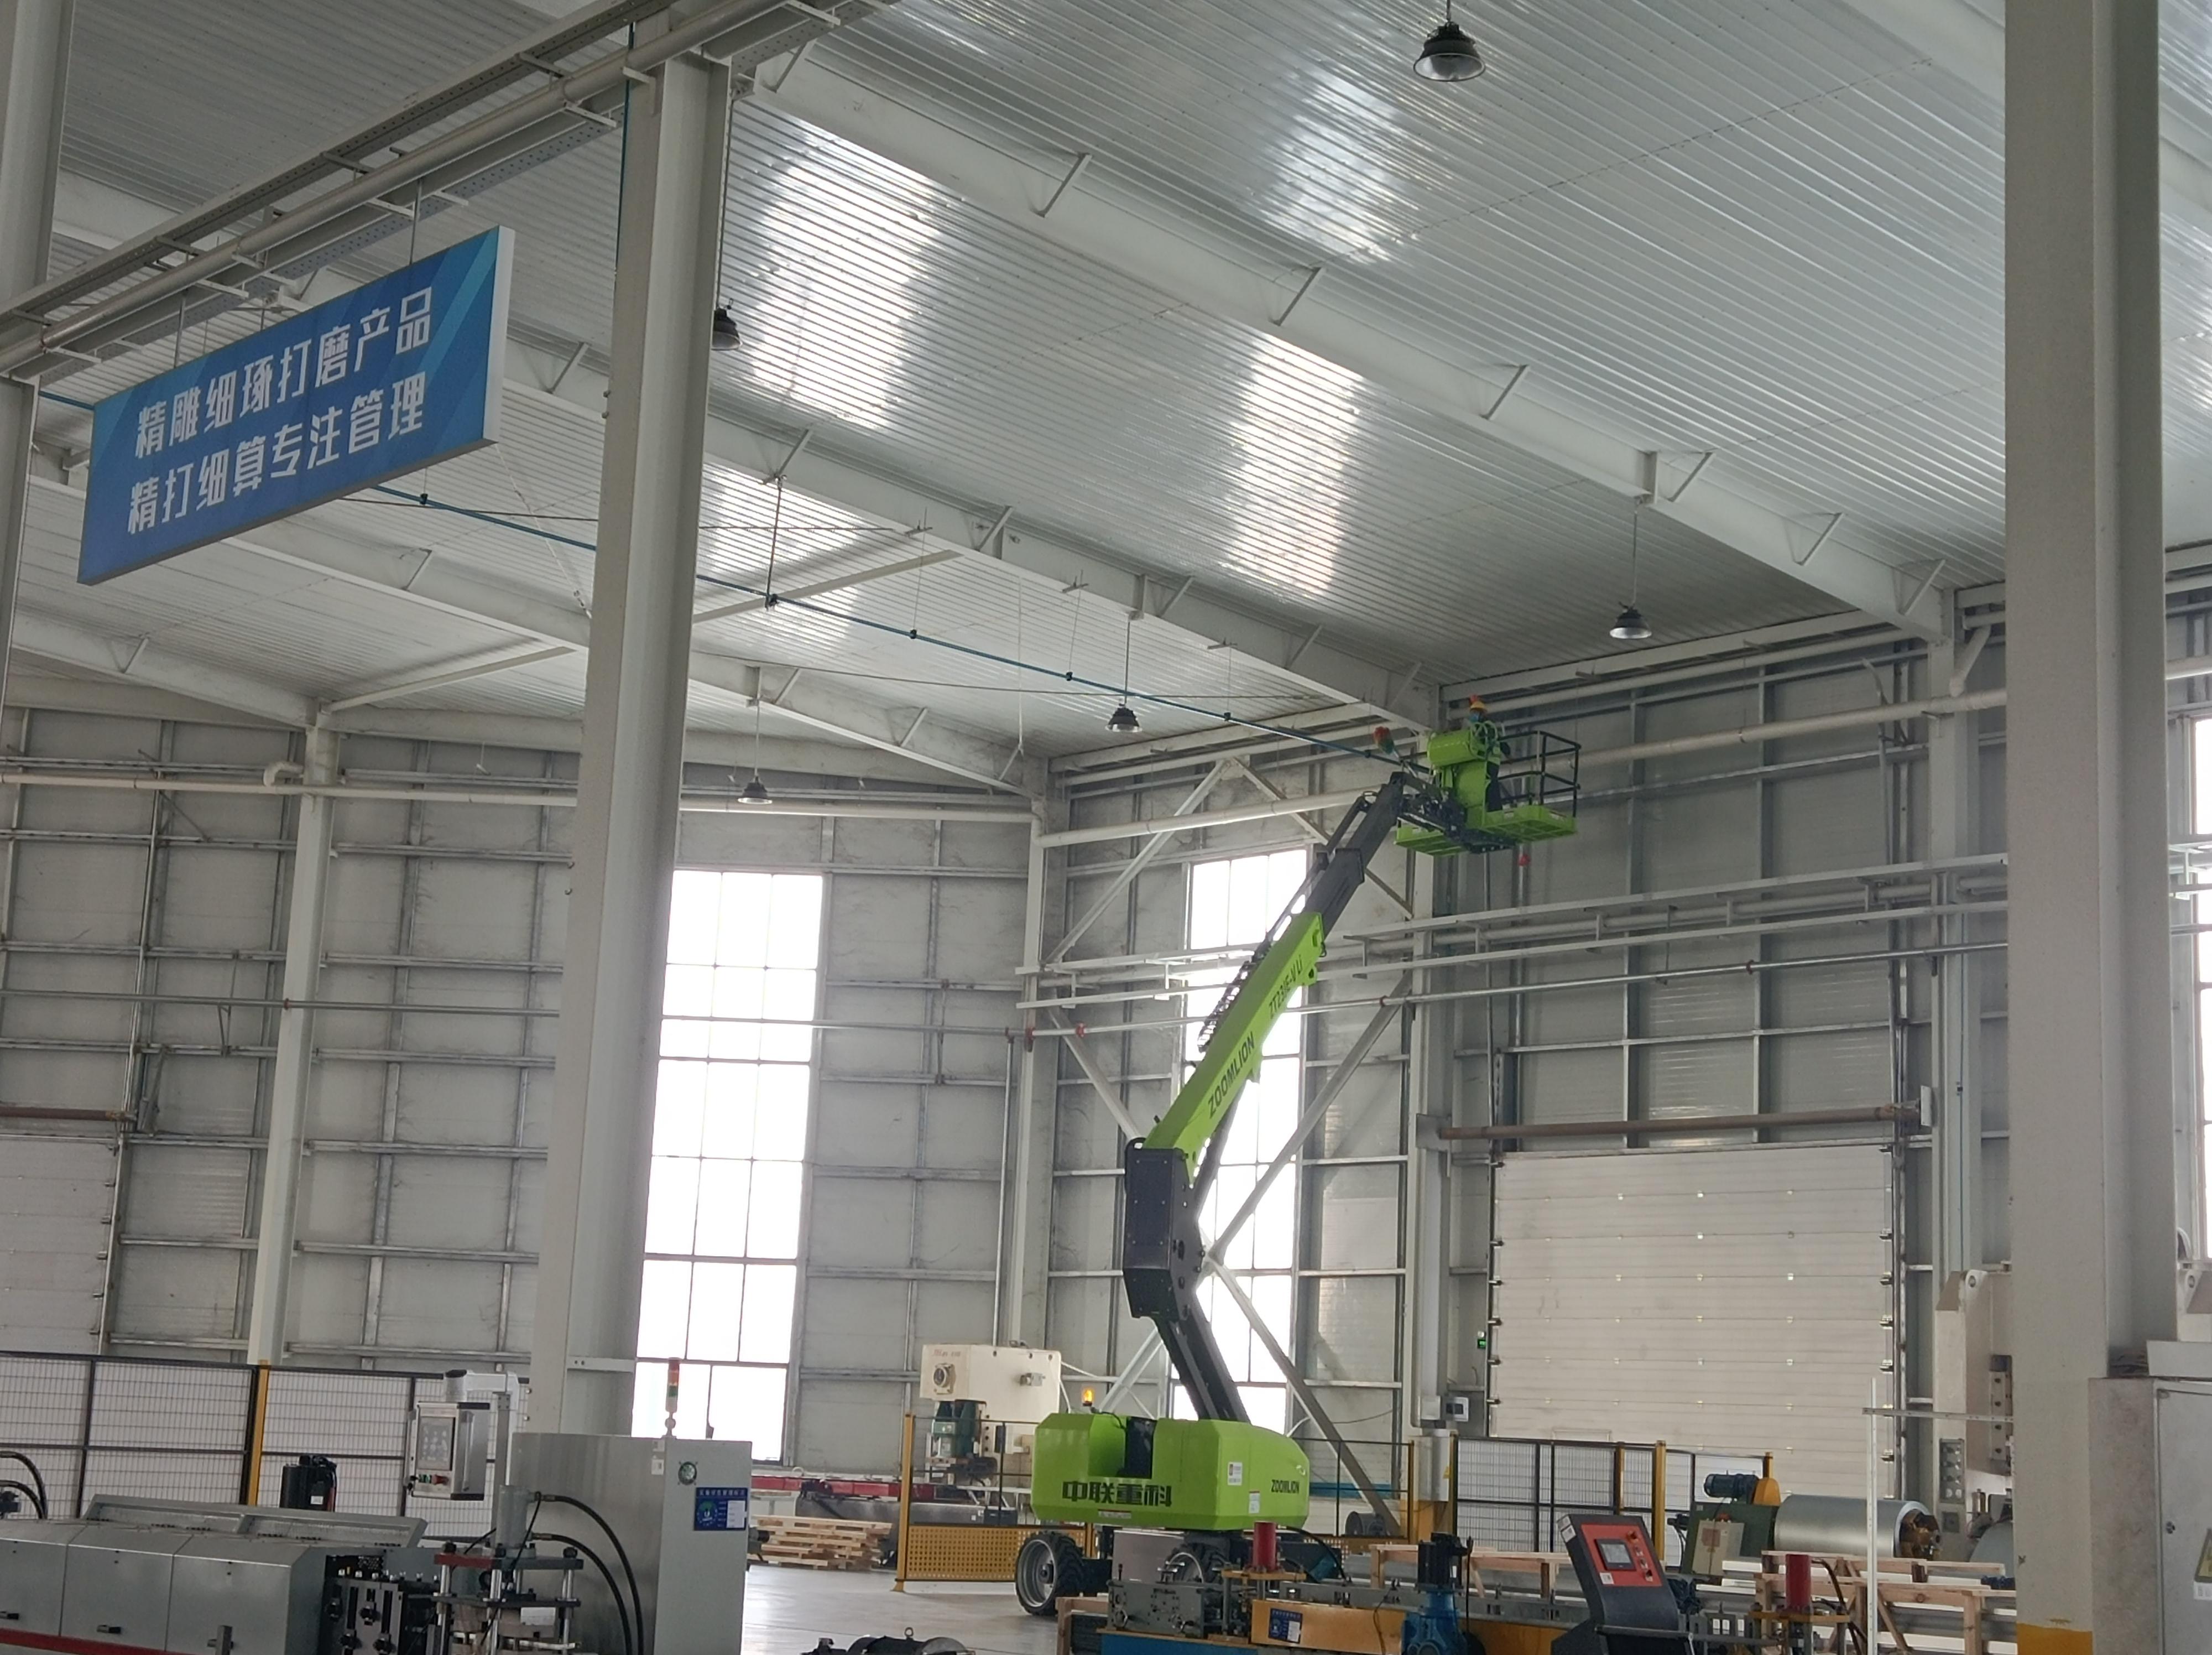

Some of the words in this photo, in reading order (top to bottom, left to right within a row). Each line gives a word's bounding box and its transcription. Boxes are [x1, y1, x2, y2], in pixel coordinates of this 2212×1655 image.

[134, 286, 432, 459] 精雕细琢打磨产品
[127, 371, 426, 535] 精打细算专注管理
[1208, 1031, 1255, 1119] ZOOMLION
[1062, 1481, 1172, 1507] 中联重科
[1271, 1479, 1300, 1494] ZOOMLION
